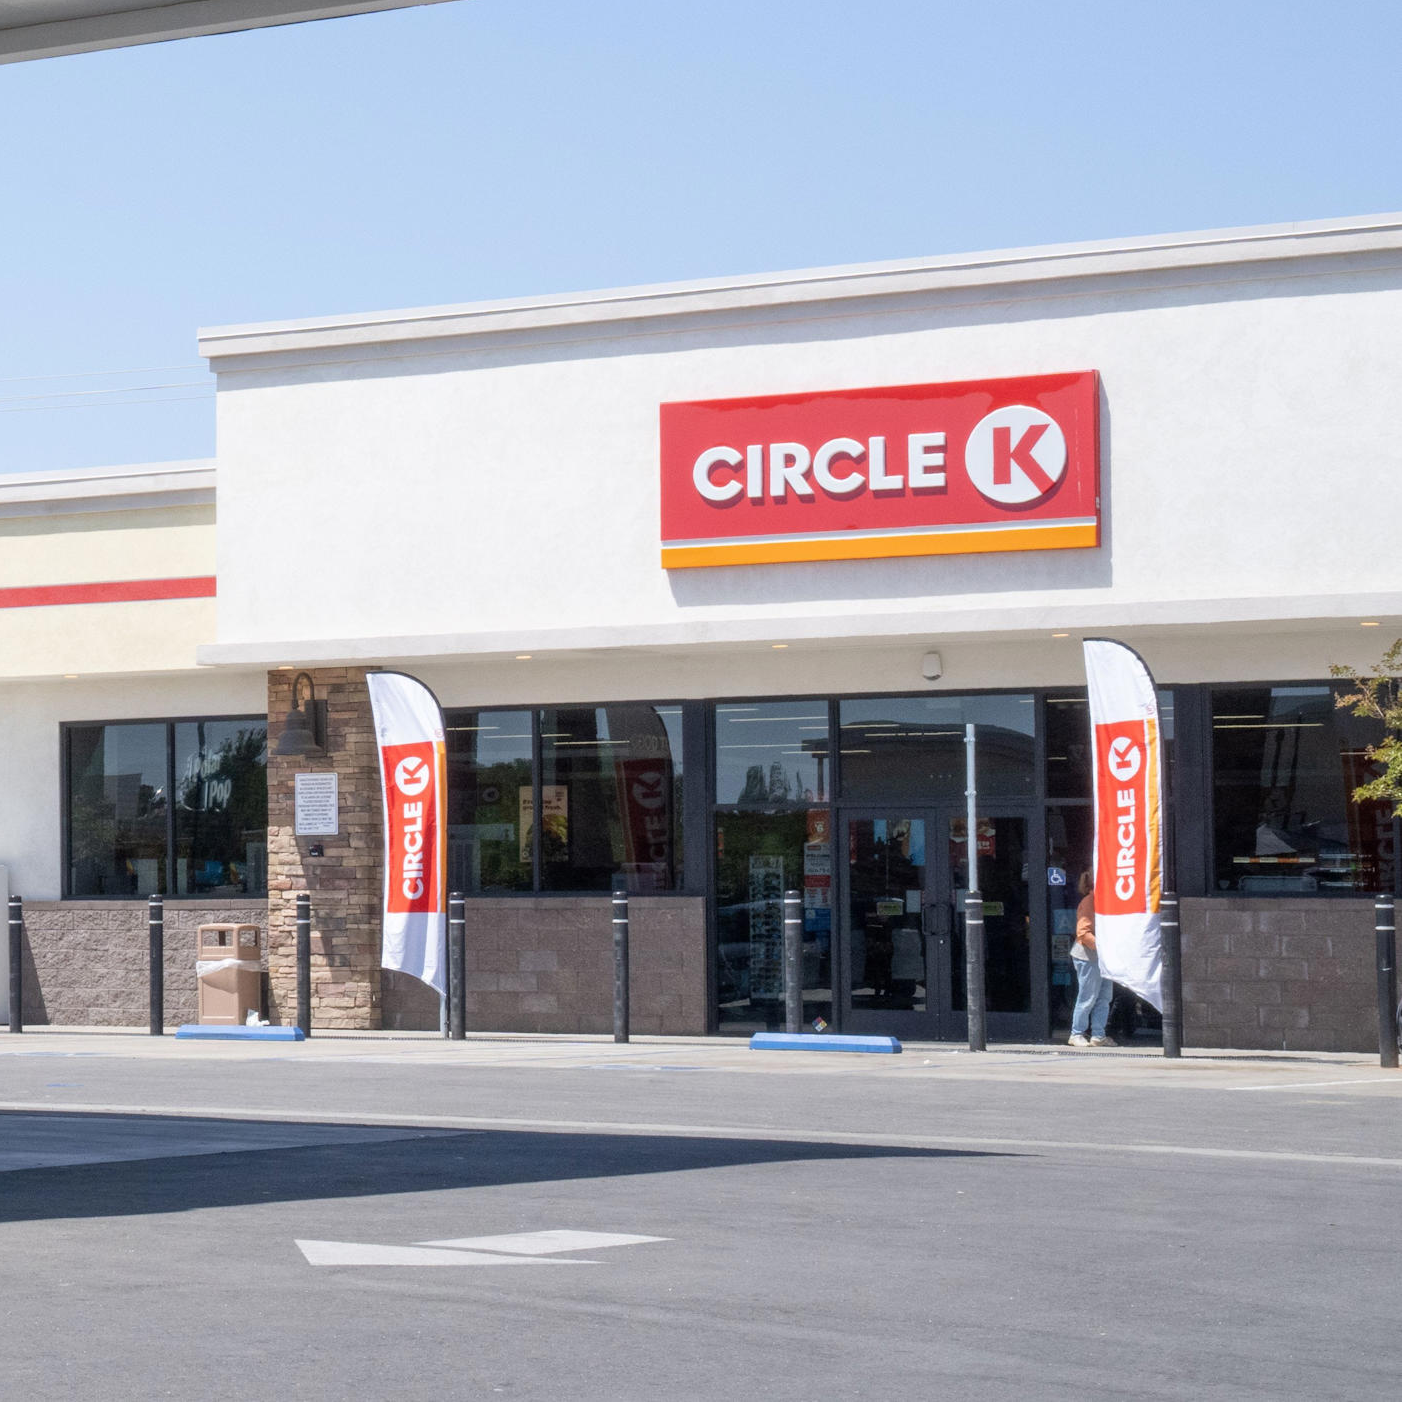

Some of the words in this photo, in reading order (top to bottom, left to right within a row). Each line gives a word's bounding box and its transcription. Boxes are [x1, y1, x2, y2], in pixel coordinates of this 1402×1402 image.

[692, 431, 947, 502] CIRCLE
[402, 801, 425, 900] CIRCLE
[1115, 789, 1136, 901] CIRCLE
